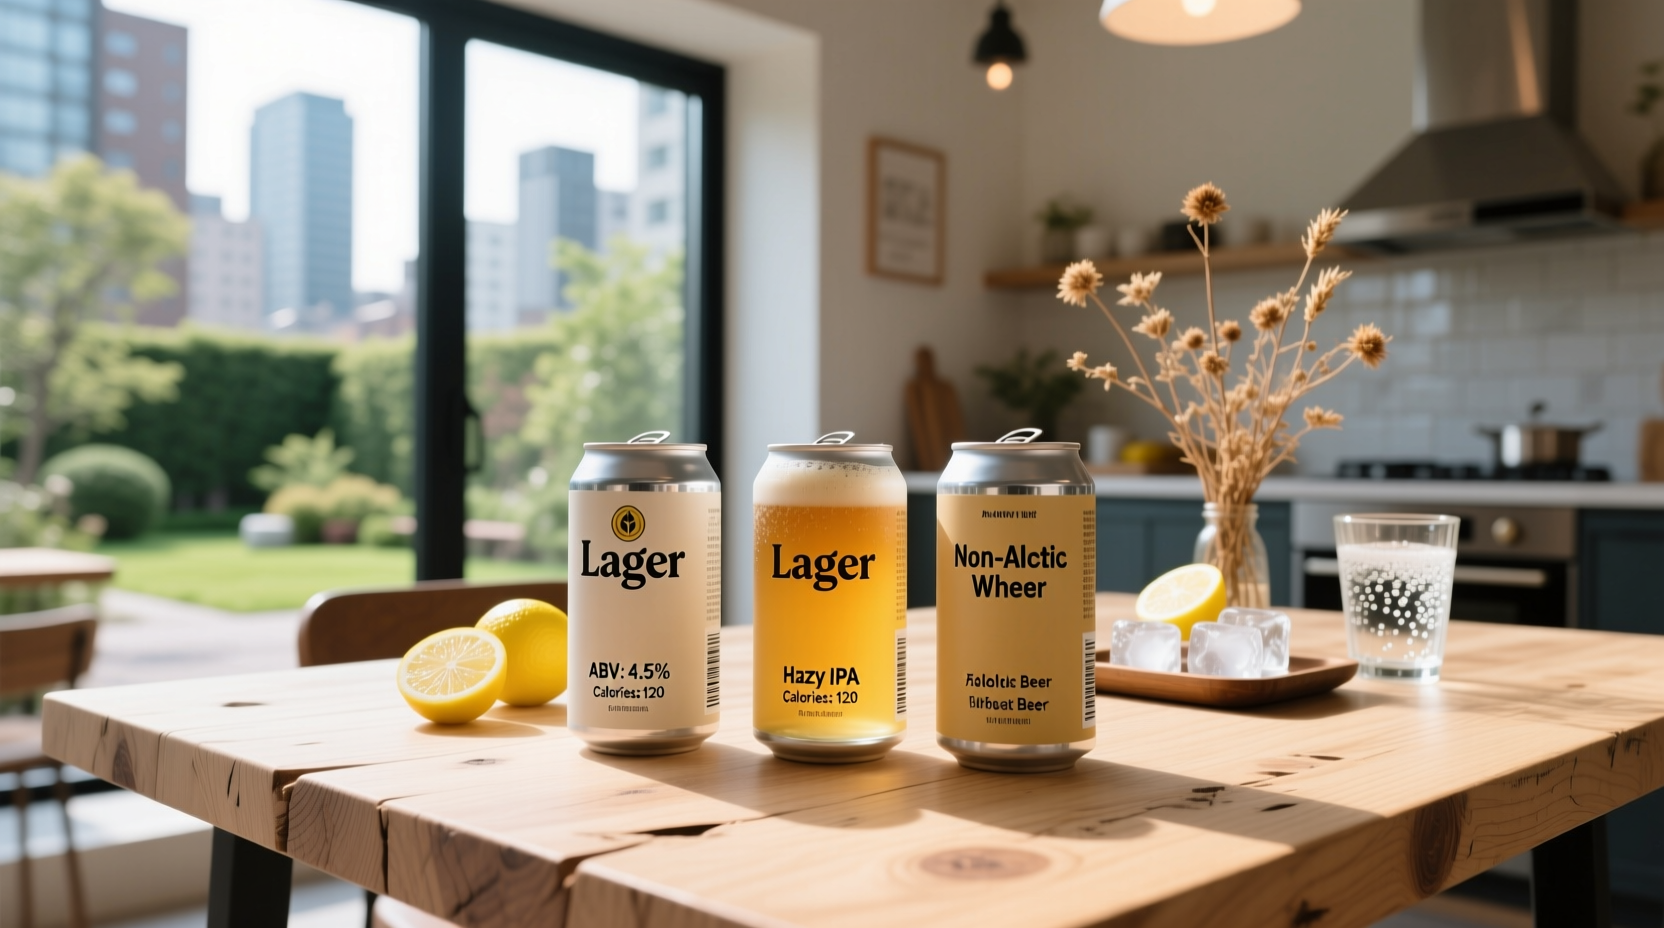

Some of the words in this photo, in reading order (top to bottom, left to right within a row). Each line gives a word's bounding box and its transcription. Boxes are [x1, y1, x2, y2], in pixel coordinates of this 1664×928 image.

[581, 540, 685, 591] Lager
[955, 543, 1067, 569] Non-Alctic
[772, 544, 876, 592] Lager
[972, 574, 1047, 598] Wheer
[589, 662, 624, 679] ABV:
[628, 662, 670, 679] 4.5%
[783, 666, 826, 689] Hazy
[830, 667, 860, 685] IPA
[1021, 675, 1052, 688] Beer
[593, 685, 640, 699] Calories:
[643, 686, 664, 699] 120
[783, 690, 833, 704] Calories:
[837, 691, 858, 704] 120
[1018, 697, 1049, 711] Beer
